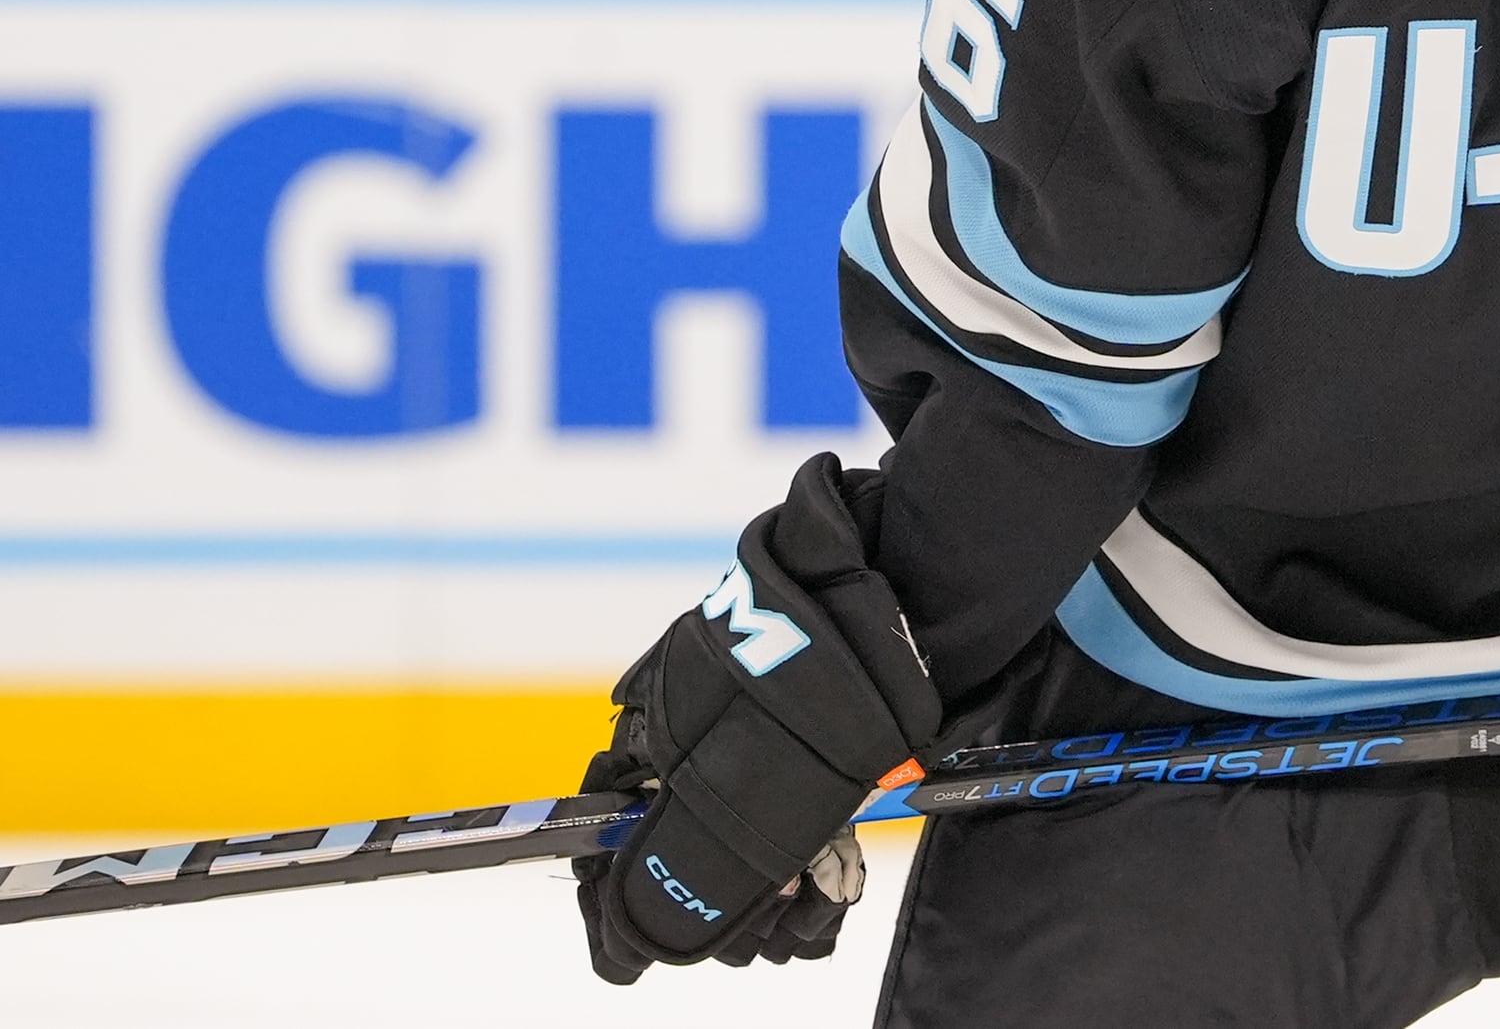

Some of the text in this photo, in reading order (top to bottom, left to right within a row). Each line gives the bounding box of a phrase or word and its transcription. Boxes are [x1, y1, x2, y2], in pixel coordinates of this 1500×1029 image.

[702, 558, 812, 677] M
[1029, 736, 1405, 799] JETSPEED
[645, 854, 722, 923] CCM
